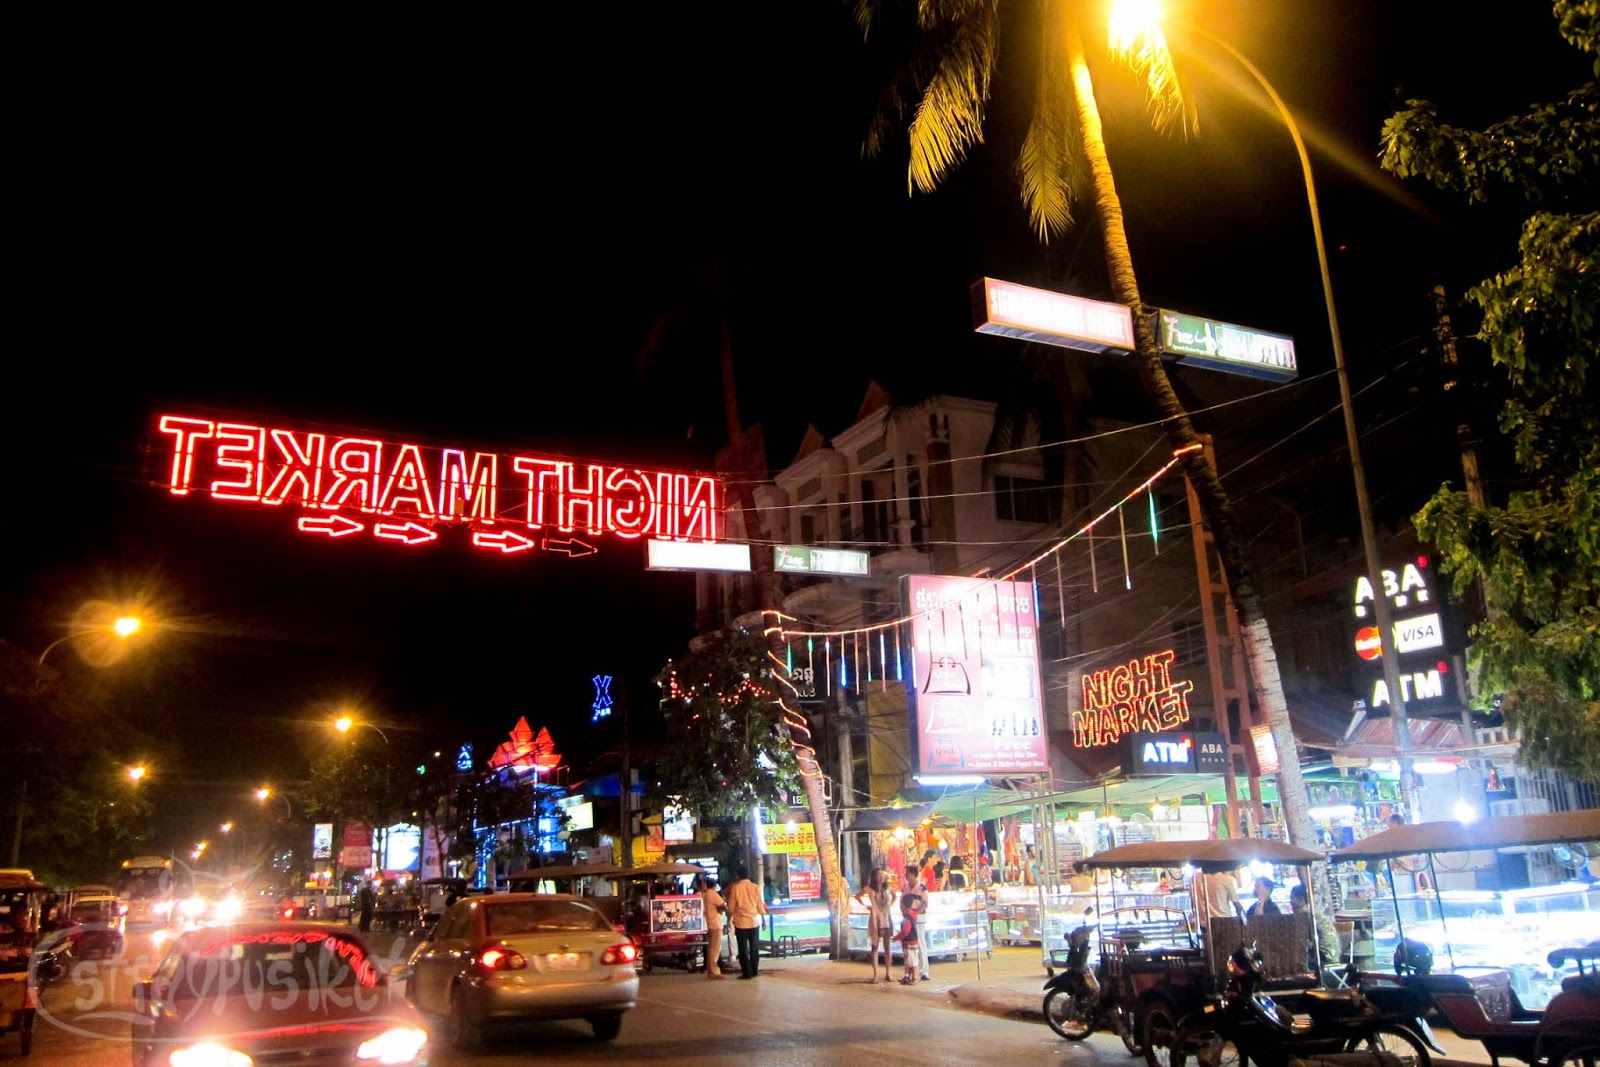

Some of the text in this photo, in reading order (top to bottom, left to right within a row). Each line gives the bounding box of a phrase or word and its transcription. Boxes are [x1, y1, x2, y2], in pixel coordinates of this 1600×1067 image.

[1355, 563, 1426, 604] ABA
[1402, 625, 1435, 643] VISA
[1082, 650, 1175, 712] NIGHT
[1372, 670, 1443, 708] ATM
[1072, 680, 1194, 748] MARKET
[1143, 741, 1190, 763] ATM
[1201, 743, 1223, 754] ABA
